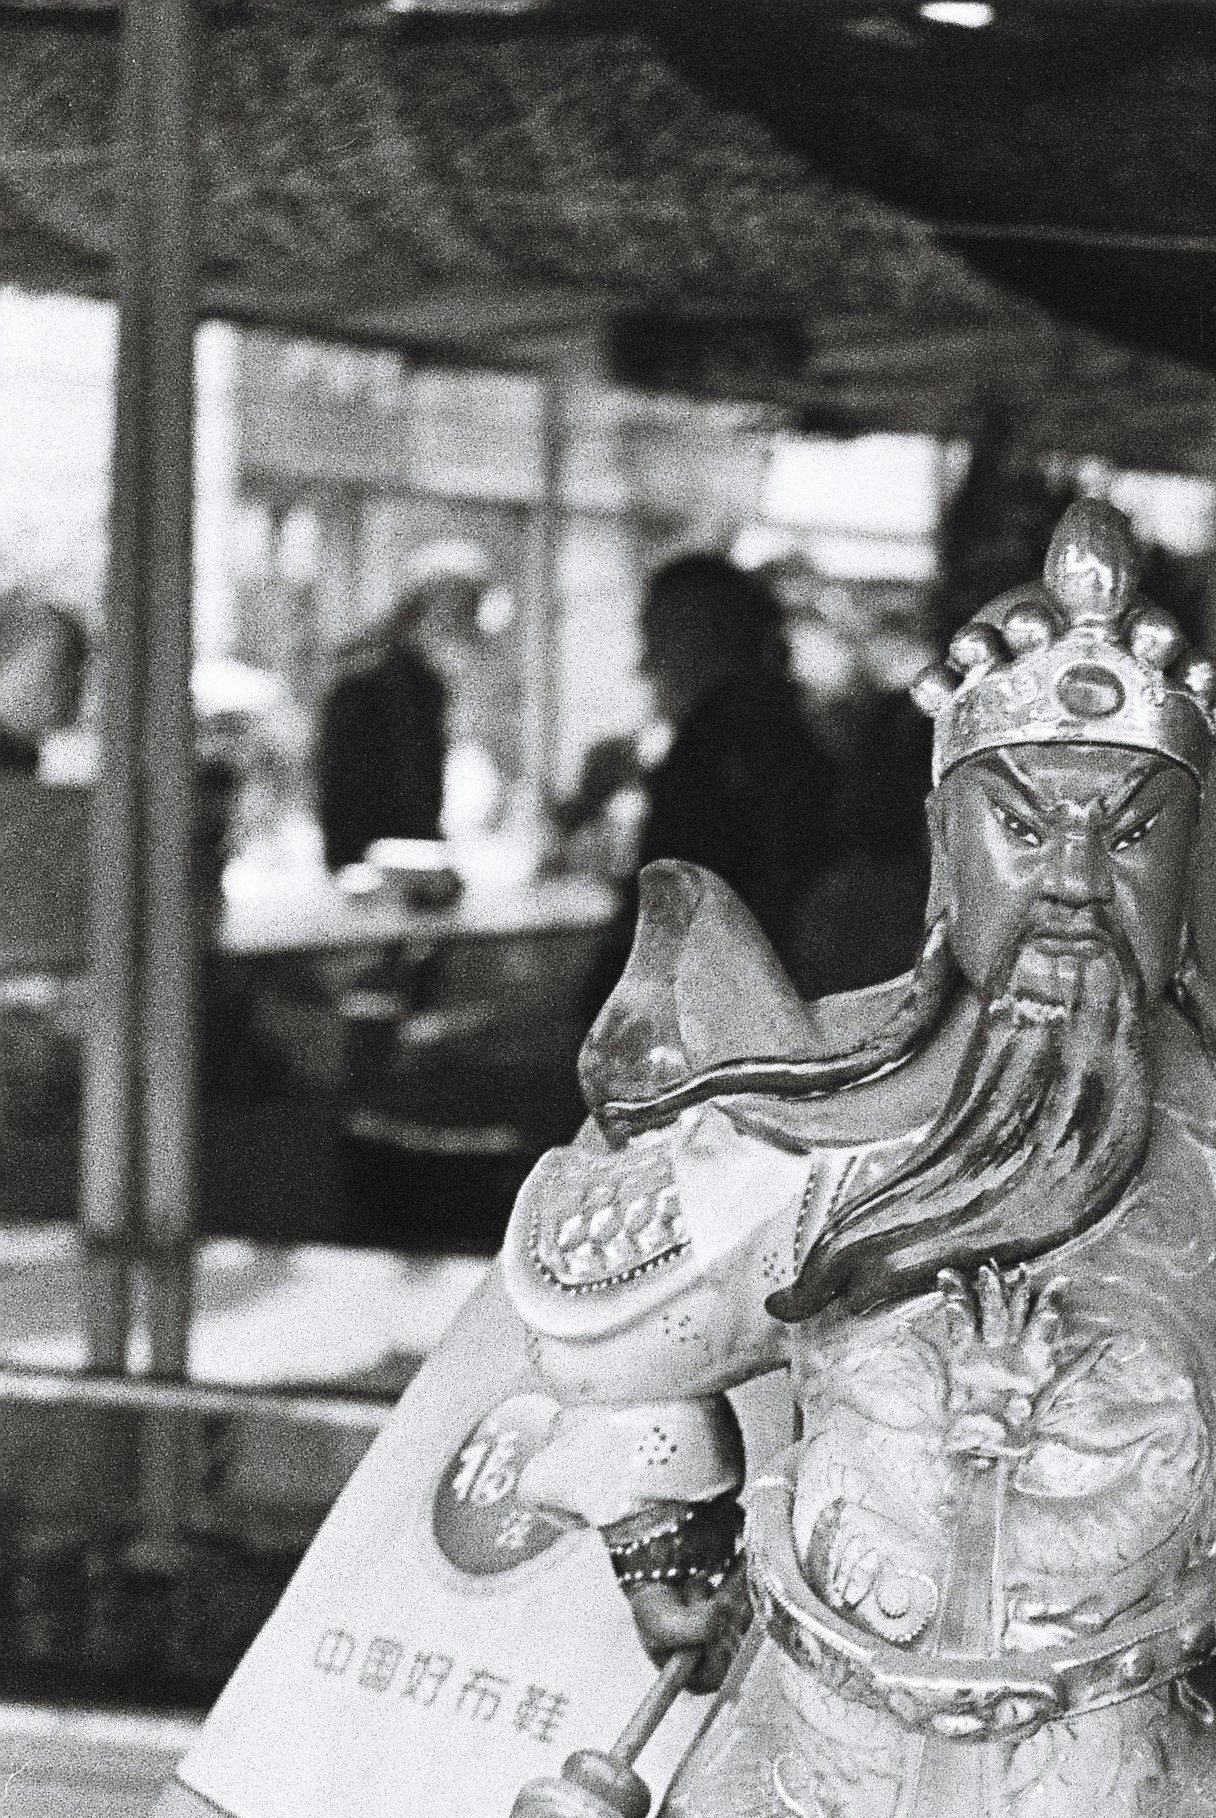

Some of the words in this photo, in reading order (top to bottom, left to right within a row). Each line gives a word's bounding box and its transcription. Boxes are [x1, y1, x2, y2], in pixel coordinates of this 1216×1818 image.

[313, 1628, 568, 1742] 中国好布鞋
